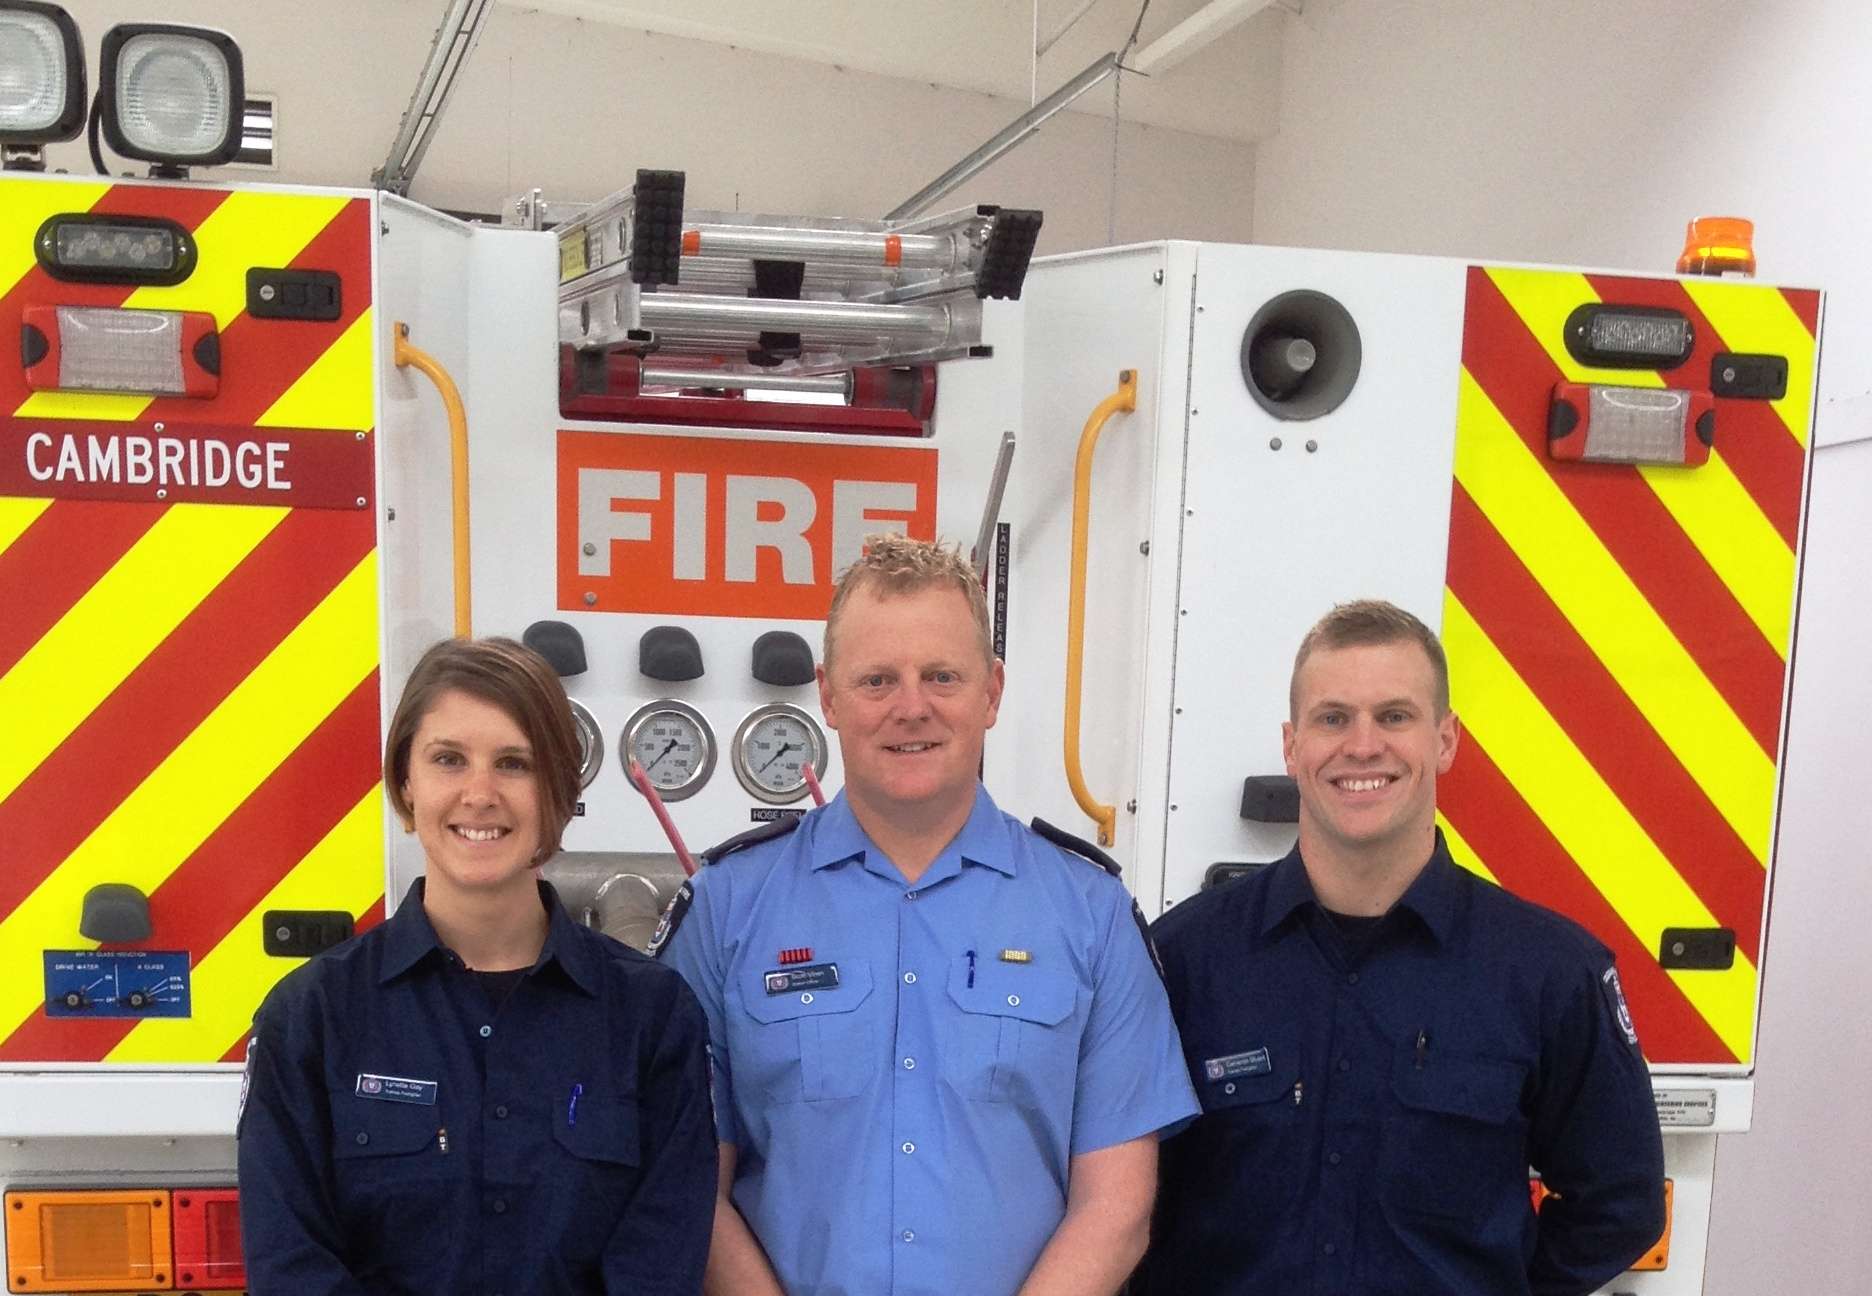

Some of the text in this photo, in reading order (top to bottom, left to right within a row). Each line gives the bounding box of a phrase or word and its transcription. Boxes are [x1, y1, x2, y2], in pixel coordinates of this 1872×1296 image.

[26, 432, 292, 490] CAMBRIDGE
[577, 467, 917, 586] FIRE
[995, 525, 1007, 653] LADDER RELEAS
[753, 810, 778, 820] HOSE
